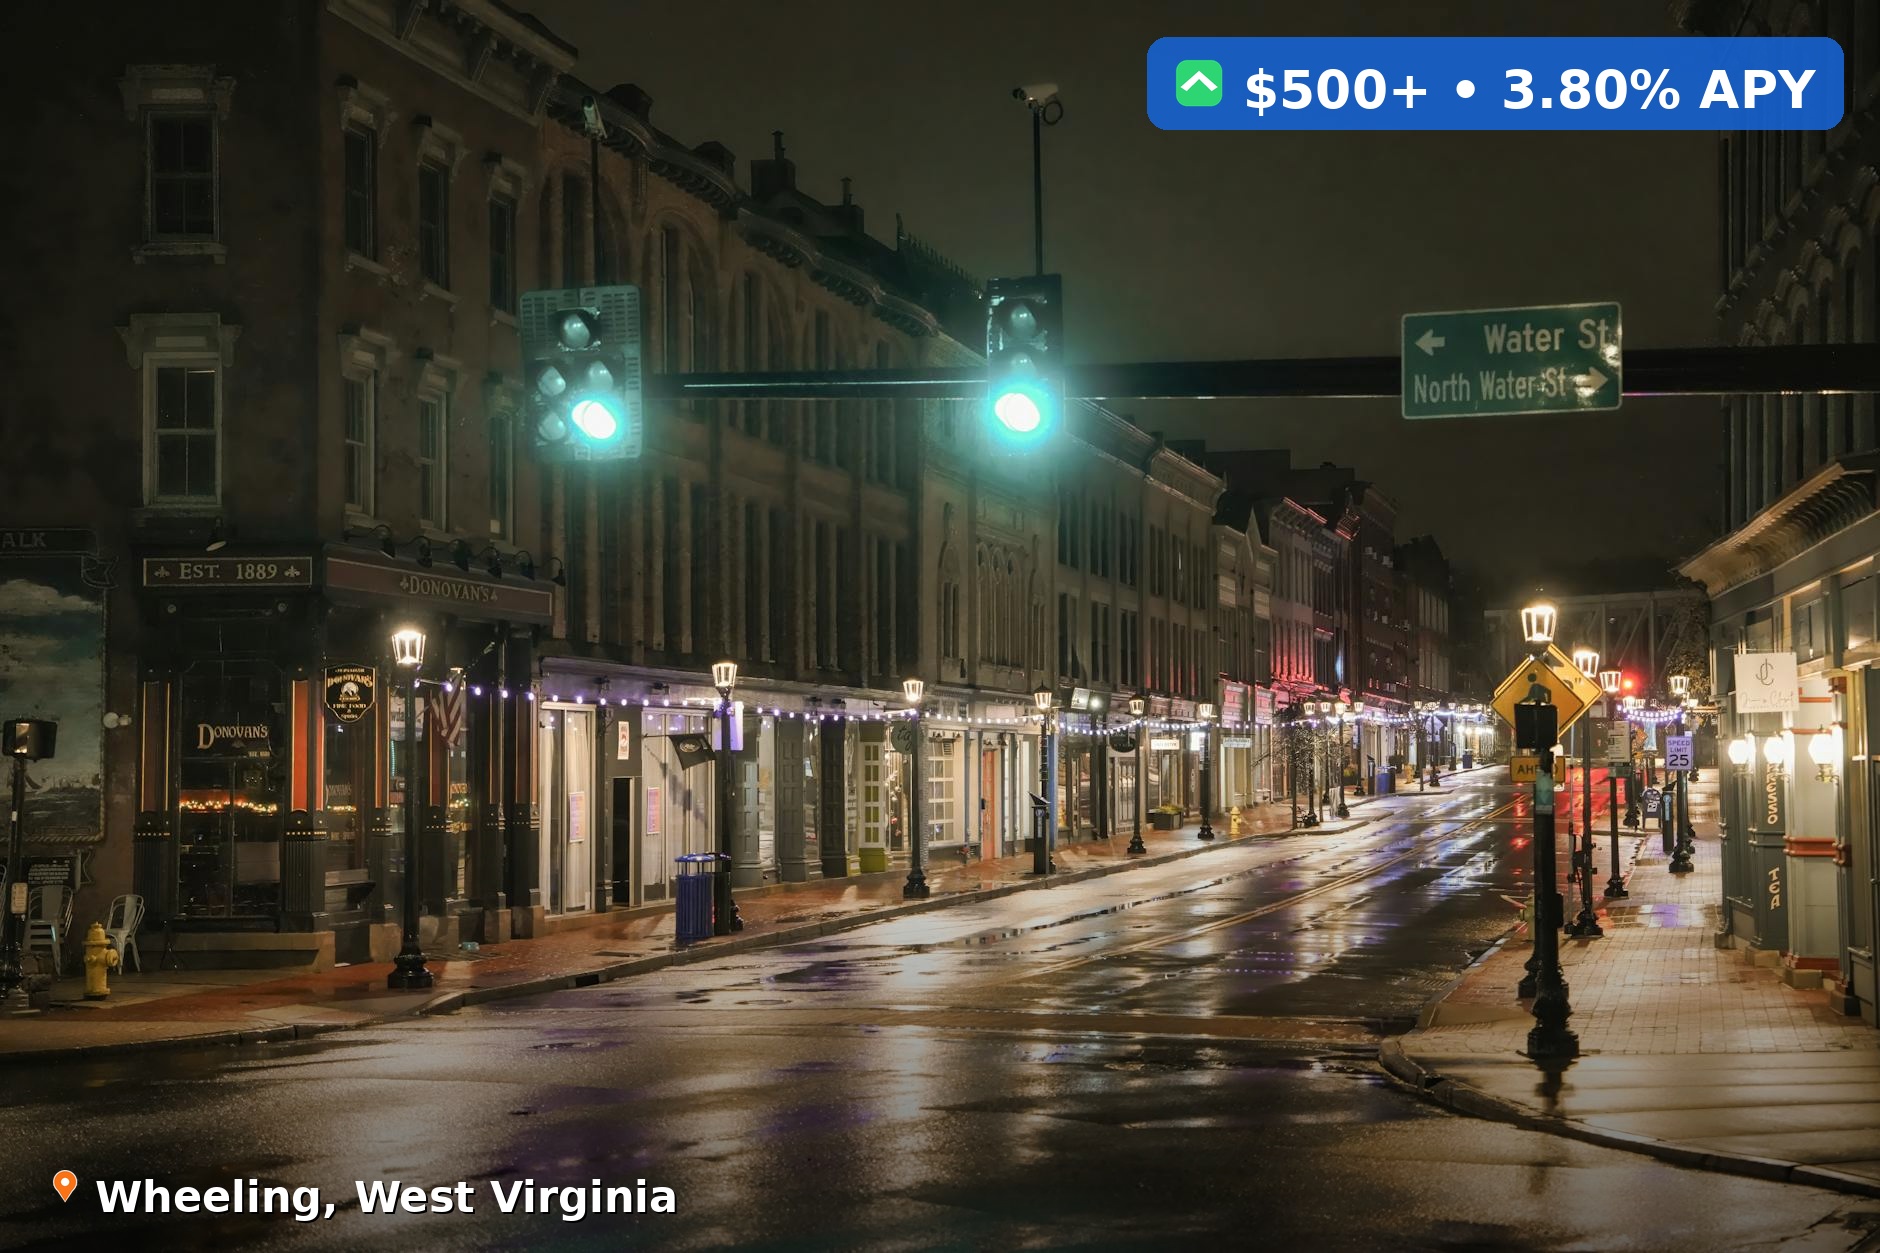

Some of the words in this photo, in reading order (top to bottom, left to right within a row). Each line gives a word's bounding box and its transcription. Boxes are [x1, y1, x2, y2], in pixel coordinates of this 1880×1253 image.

[1484, 322, 1565, 354] Water
[1578, 318, 1609, 349] St
[1414, 371, 1471, 404] North
[1480, 370, 1537, 400] Water
[1545, 366, 1567, 397] St
[178, 562, 222, 580] EST.
[236, 563, 278, 580] 1889
[409, 575, 489, 602] DONOVAN'S
[197, 723, 269, 750] DONOVAN'S
[1669, 754, 1689, 767] 25
[1768, 867, 1781, 911] TEA
